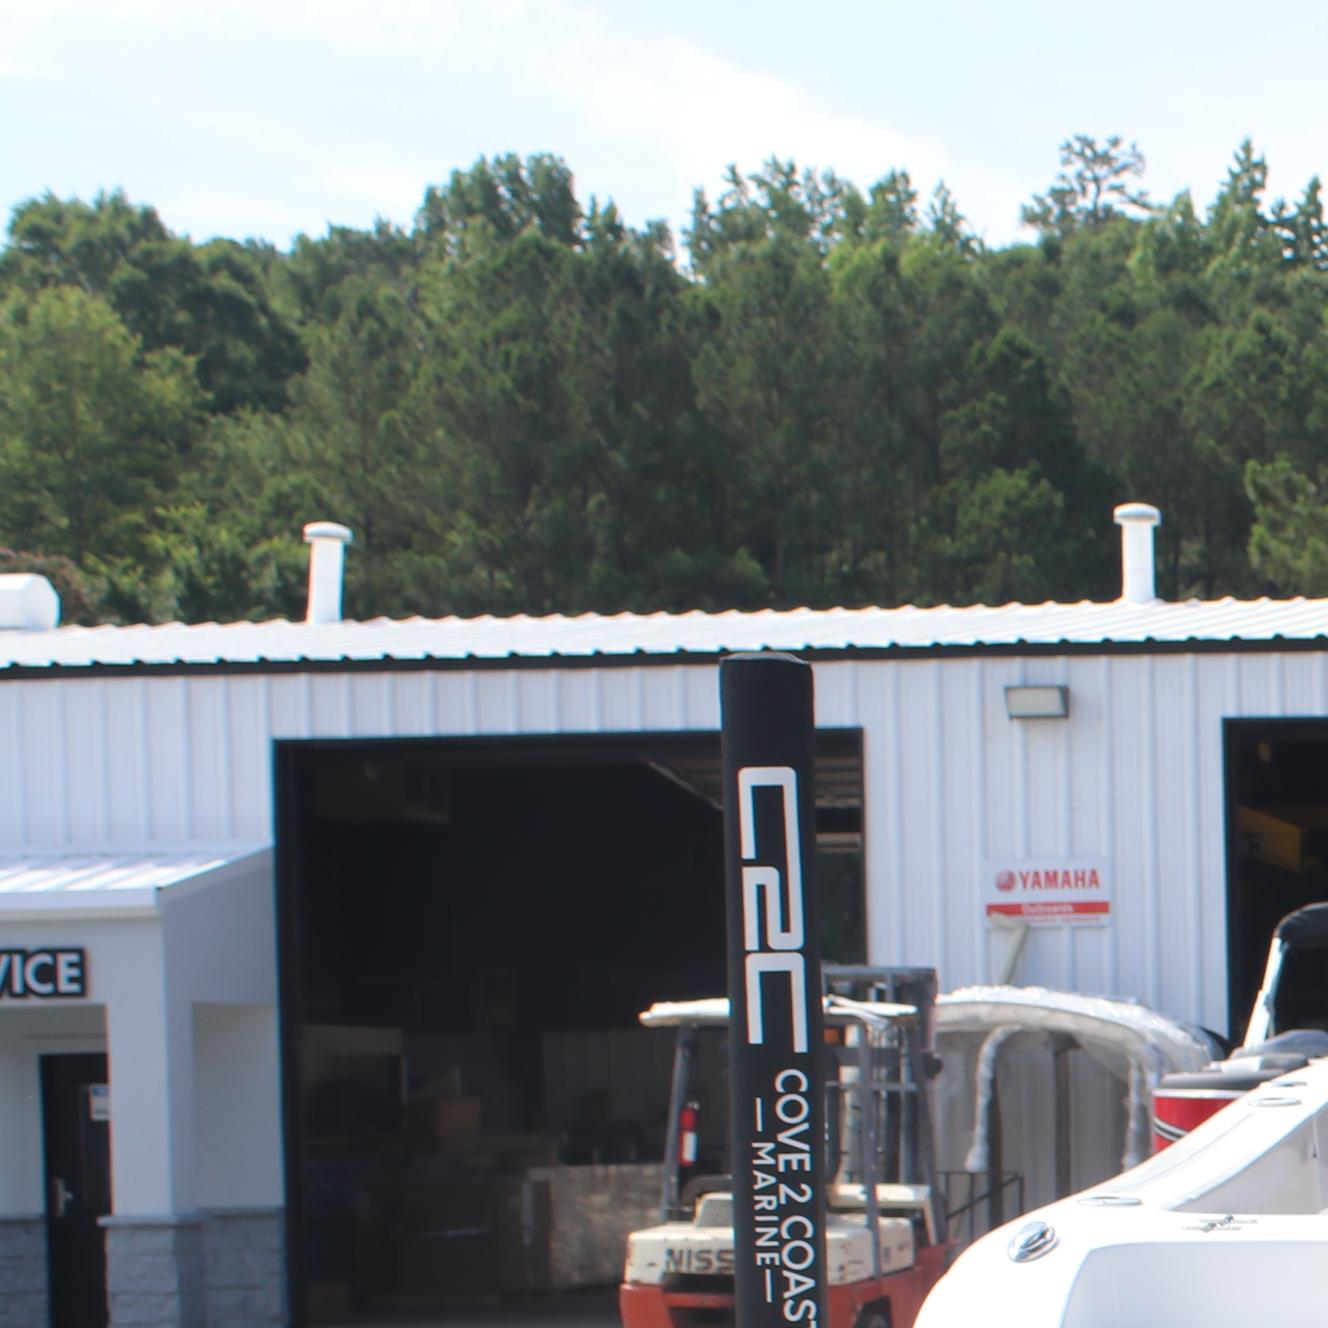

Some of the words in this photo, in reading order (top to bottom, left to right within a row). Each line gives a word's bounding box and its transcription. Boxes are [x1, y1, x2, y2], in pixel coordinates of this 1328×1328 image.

[1019, 868, 1100, 891] YAMAHA
[774, 1068, 811, 1173] COVE
[751, 1141, 781, 1267] MARINE
[778, 1183, 813, 1205] 2
[667, 1248, 735, 1274] NISS
